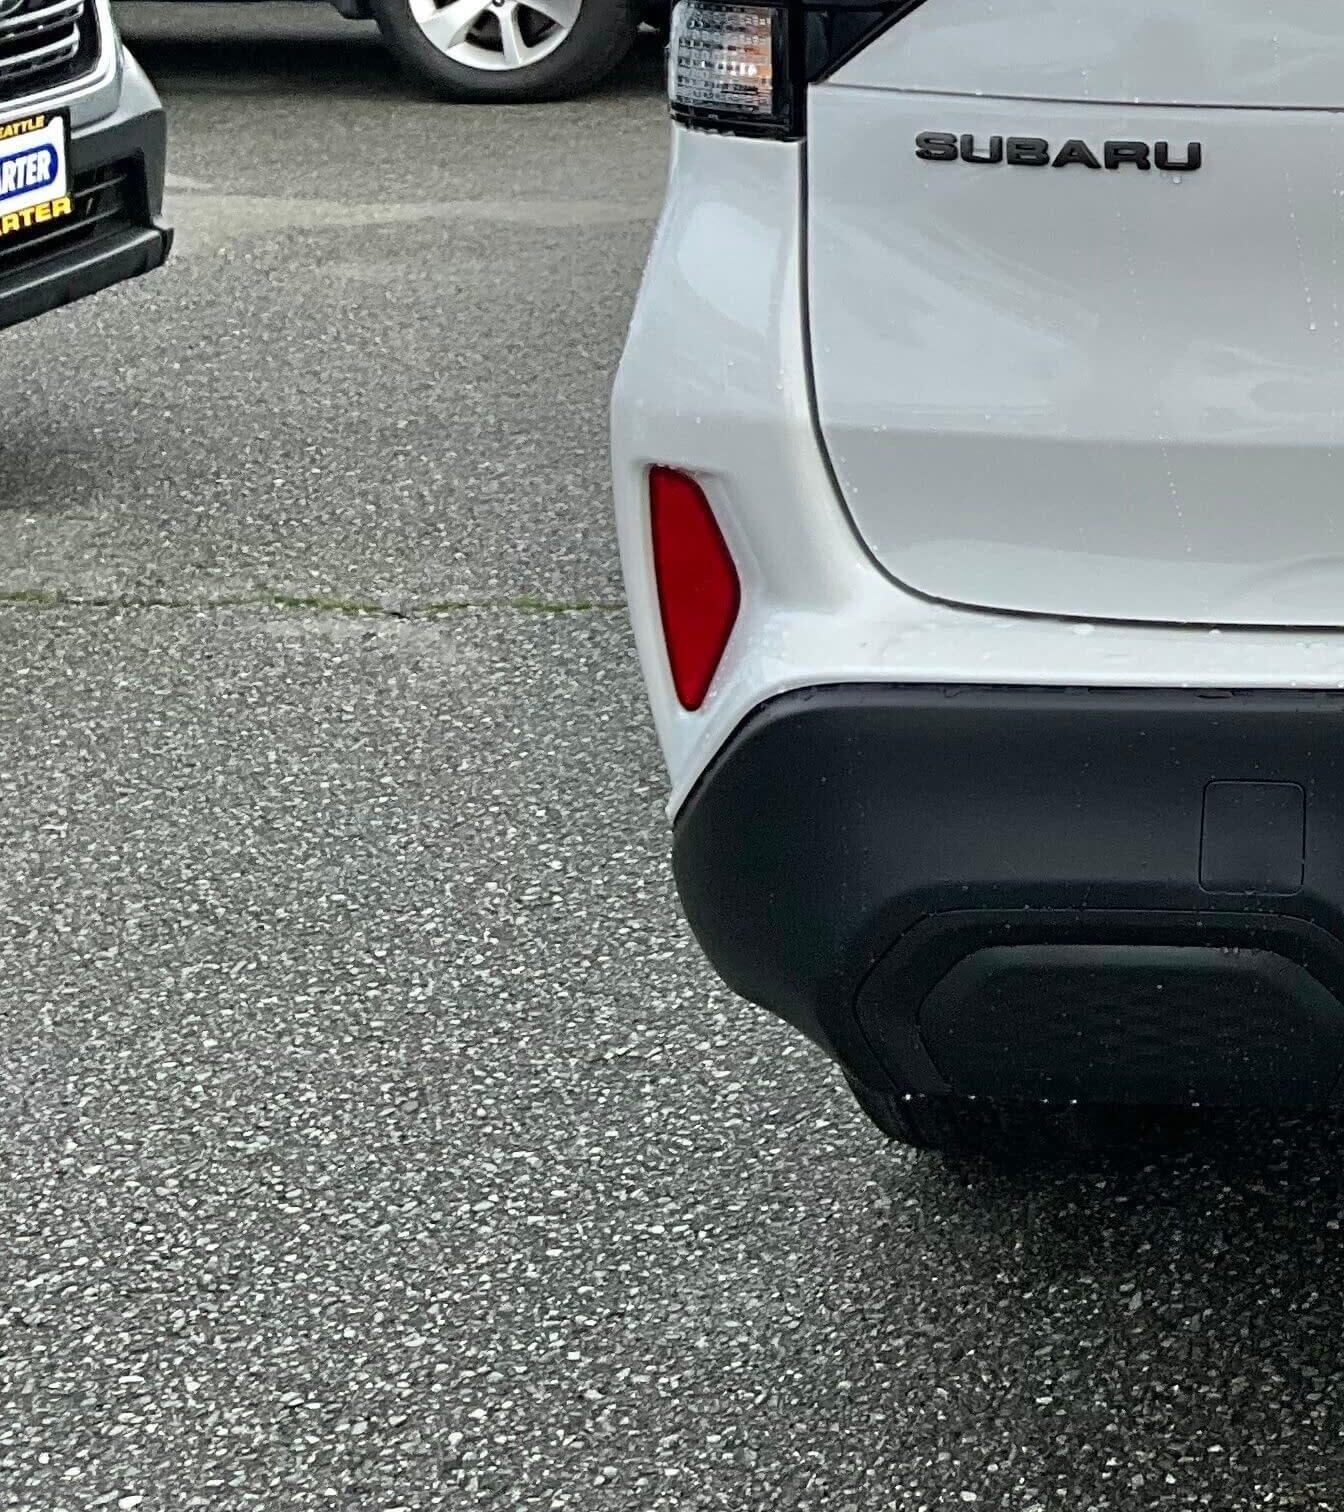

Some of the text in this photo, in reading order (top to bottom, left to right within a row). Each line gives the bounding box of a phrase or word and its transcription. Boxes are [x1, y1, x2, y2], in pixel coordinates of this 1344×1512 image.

[0, 114, 46, 139] EATTLE
[0, 149, 52, 193] RTER
[914, 131, 1202, 171] SUBARU
[0, 195, 72, 236] RTER
